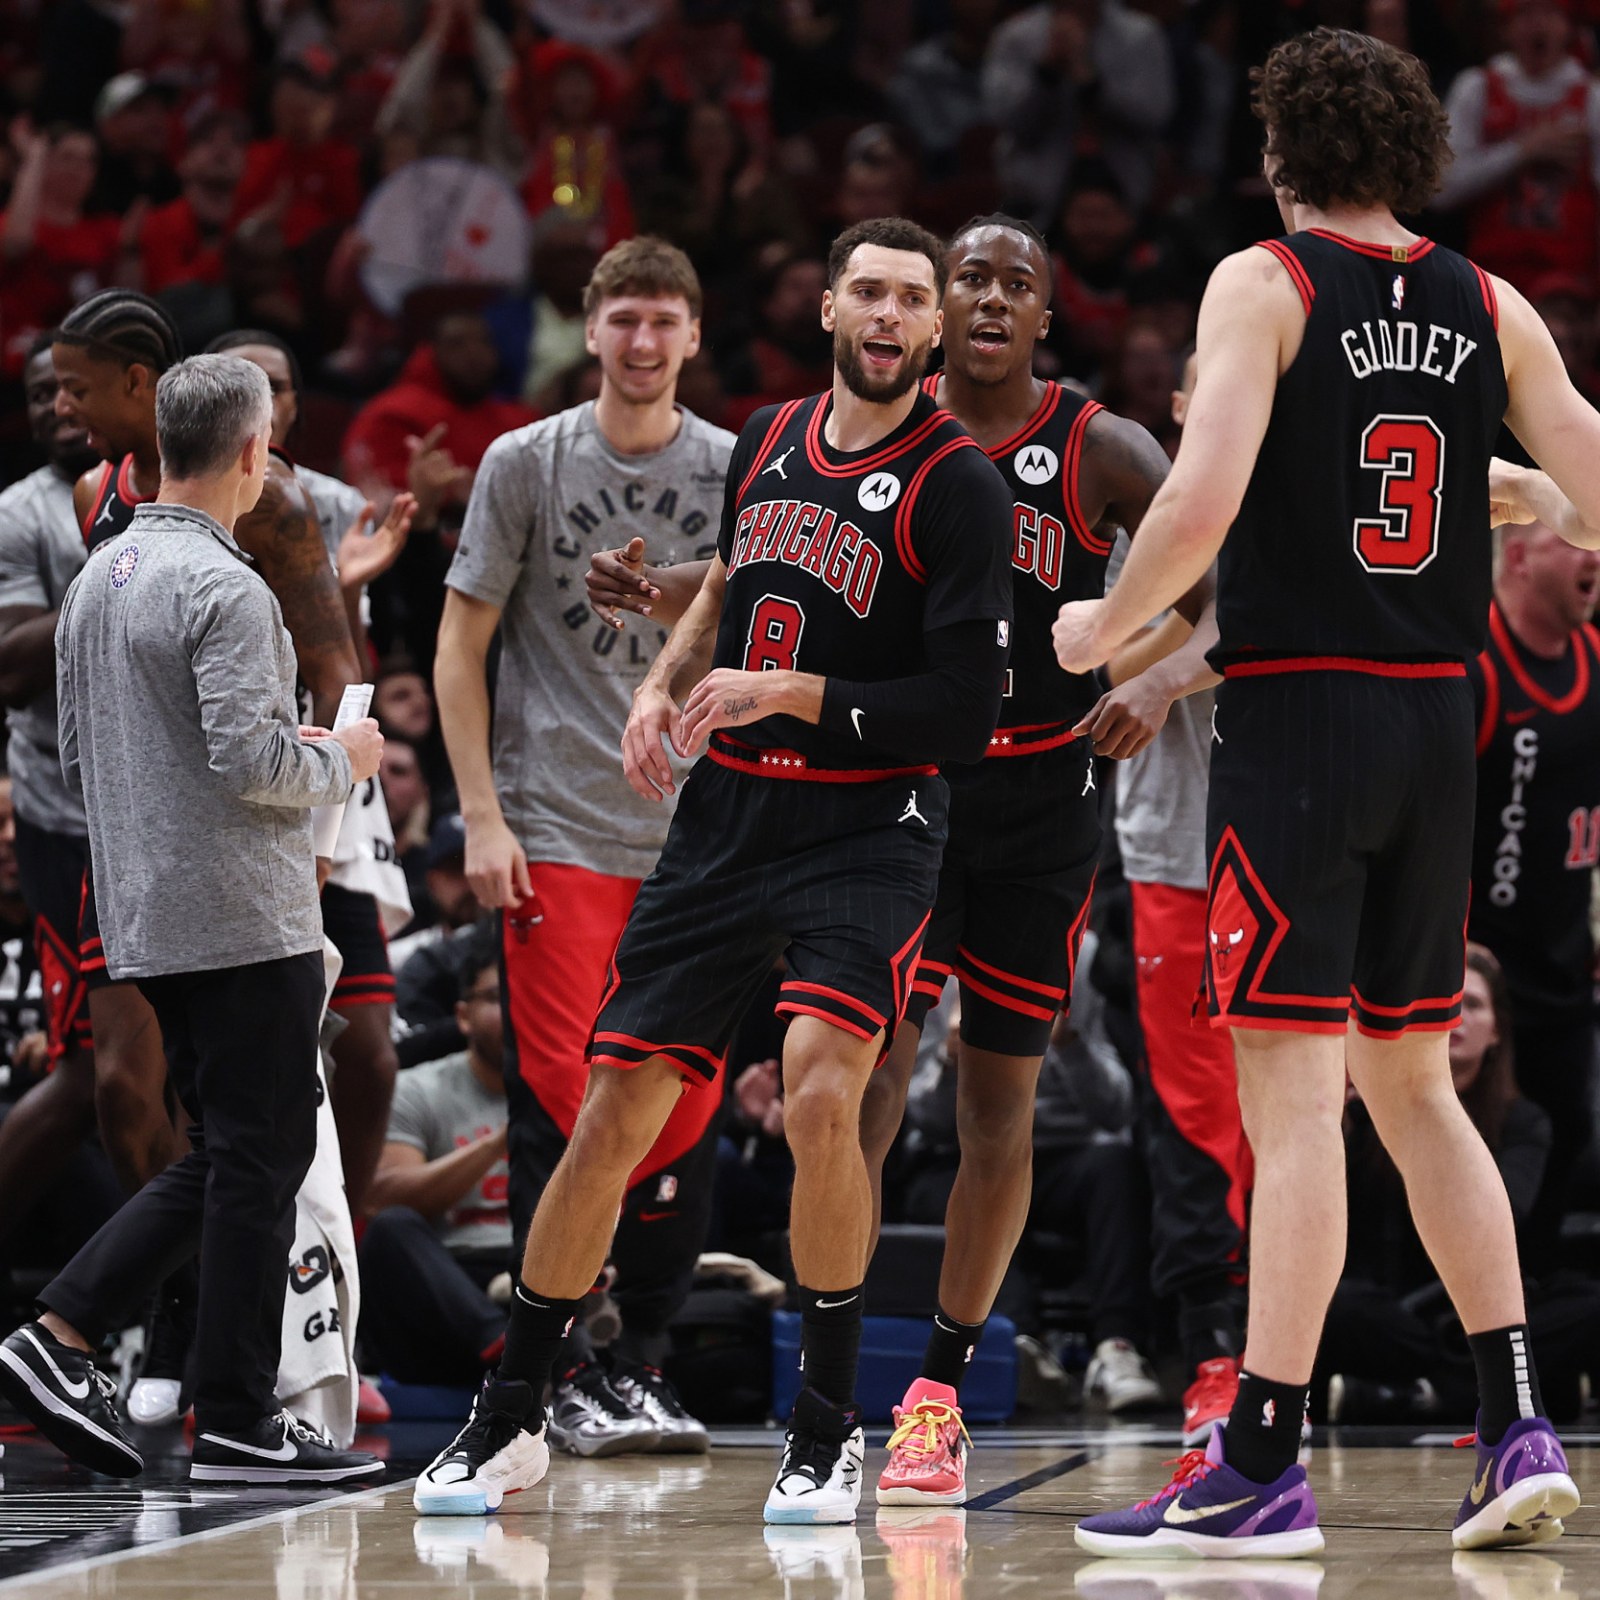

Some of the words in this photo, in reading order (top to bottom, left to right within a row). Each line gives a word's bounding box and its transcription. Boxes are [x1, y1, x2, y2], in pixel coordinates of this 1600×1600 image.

[1340, 319, 1478, 385] GIDDEY
[1353, 413, 1446, 575] 3
[726, 499, 884, 619] CHICAGO
[742, 593, 806, 673] 8
[1489, 728, 1539, 907] CHICAGO
